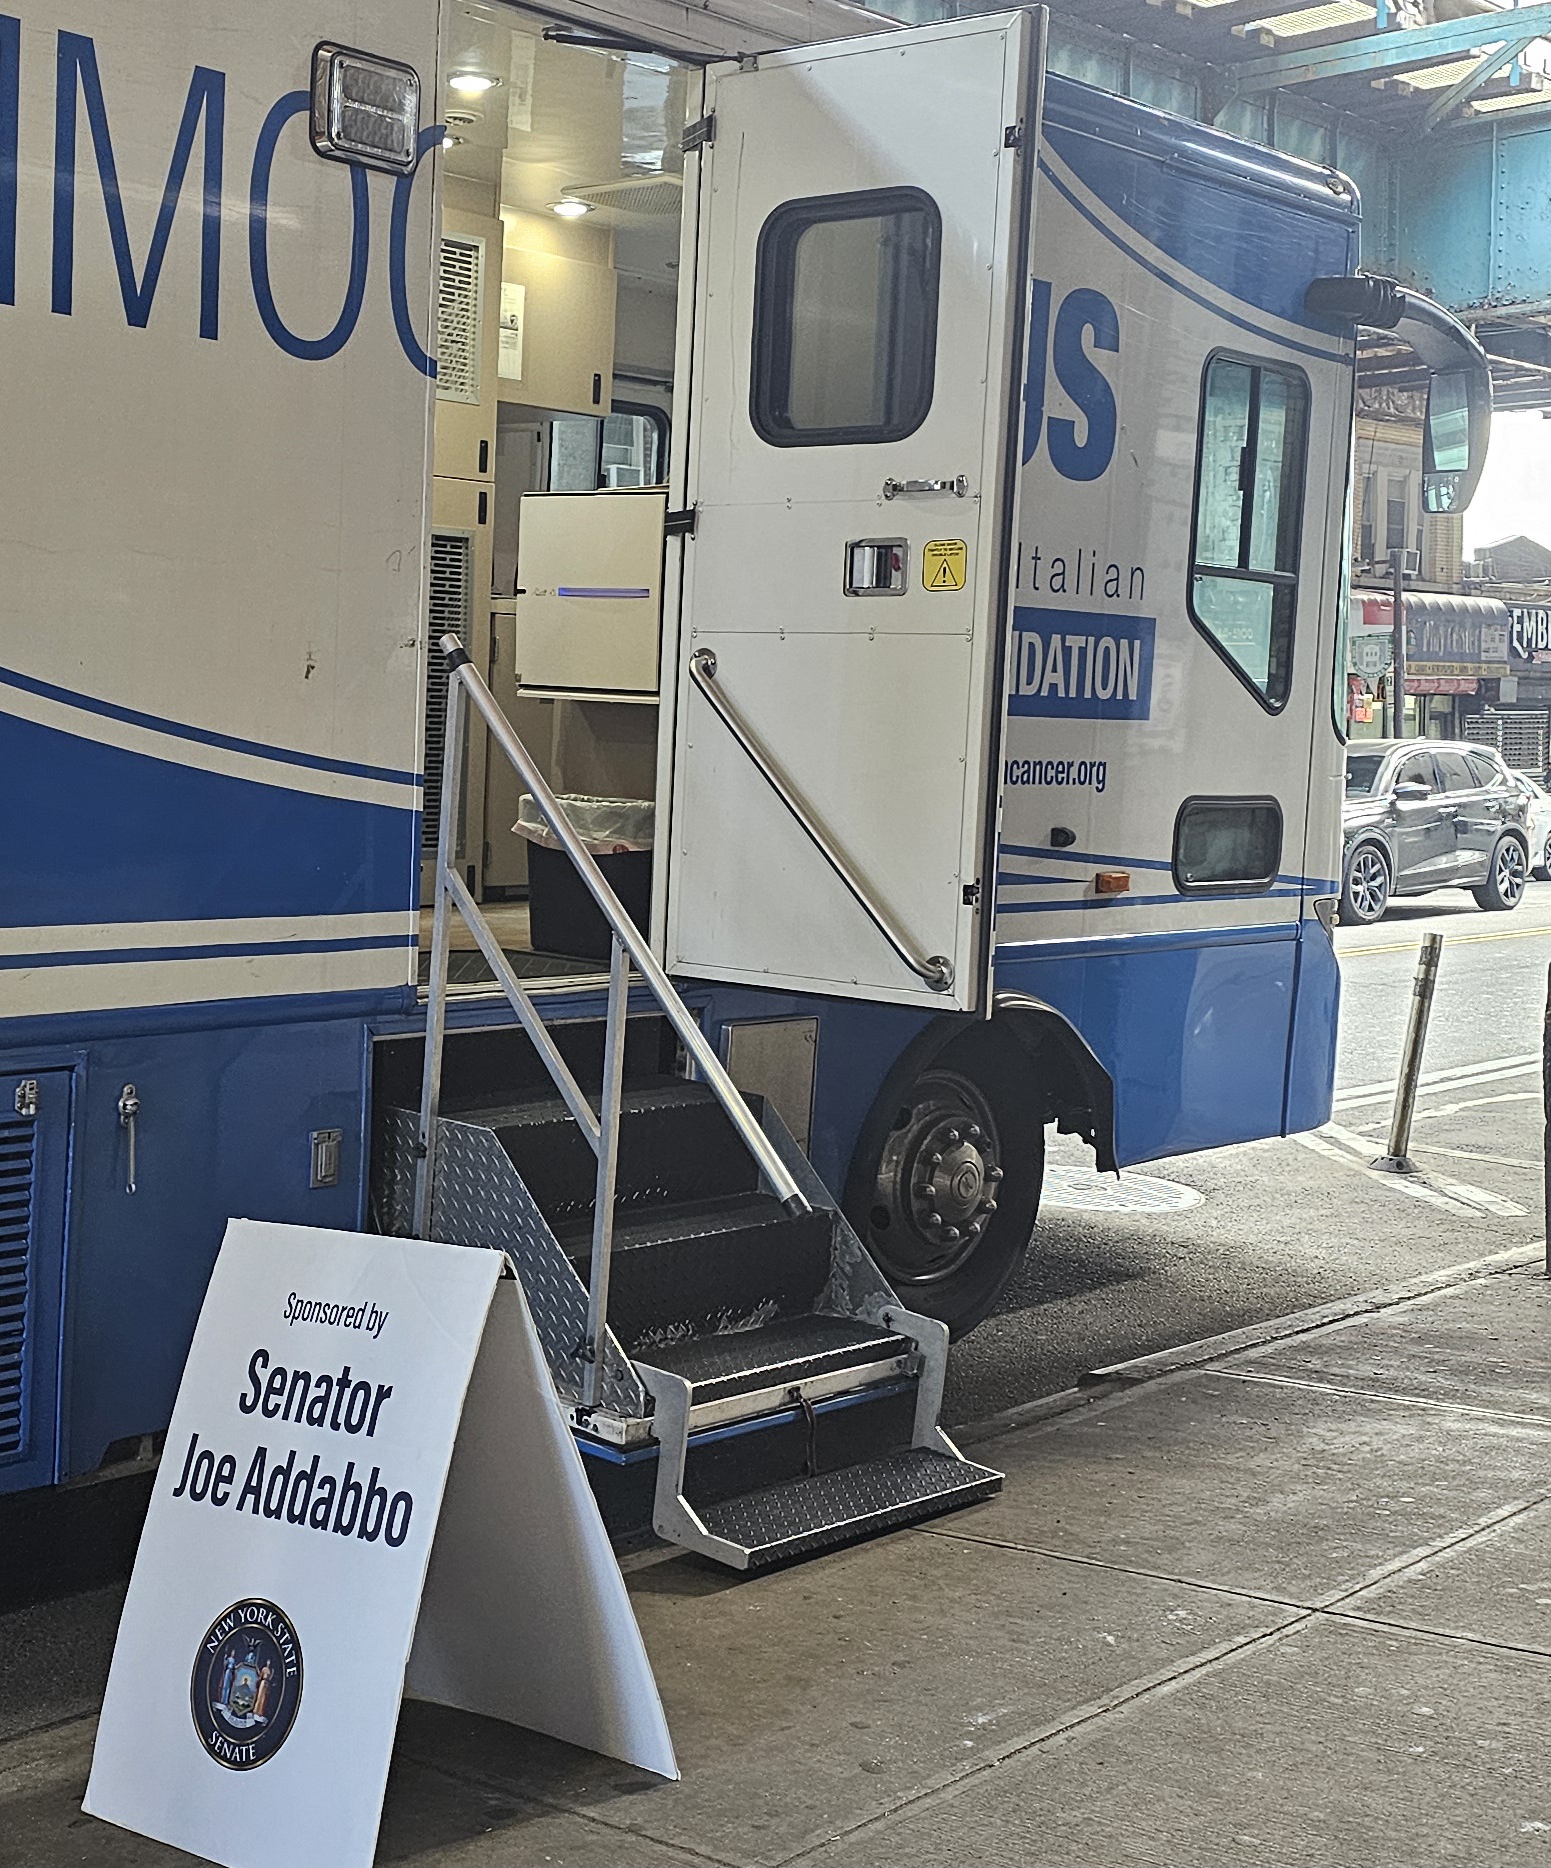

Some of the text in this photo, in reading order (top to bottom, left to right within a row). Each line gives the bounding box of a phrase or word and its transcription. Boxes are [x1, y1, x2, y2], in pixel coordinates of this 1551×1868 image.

[1015, 542, 1145, 600] Italian
[1512, 608, 1551, 659] EMB
[284, 1292, 389, 1339] Sponsored by
[239, 1349, 393, 1437] Senator
[172, 1433, 414, 1547] Joe Addabbo
[206, 1606, 298, 1678] NEW YORK STATE
[209, 1730, 256, 1762] SENATE
